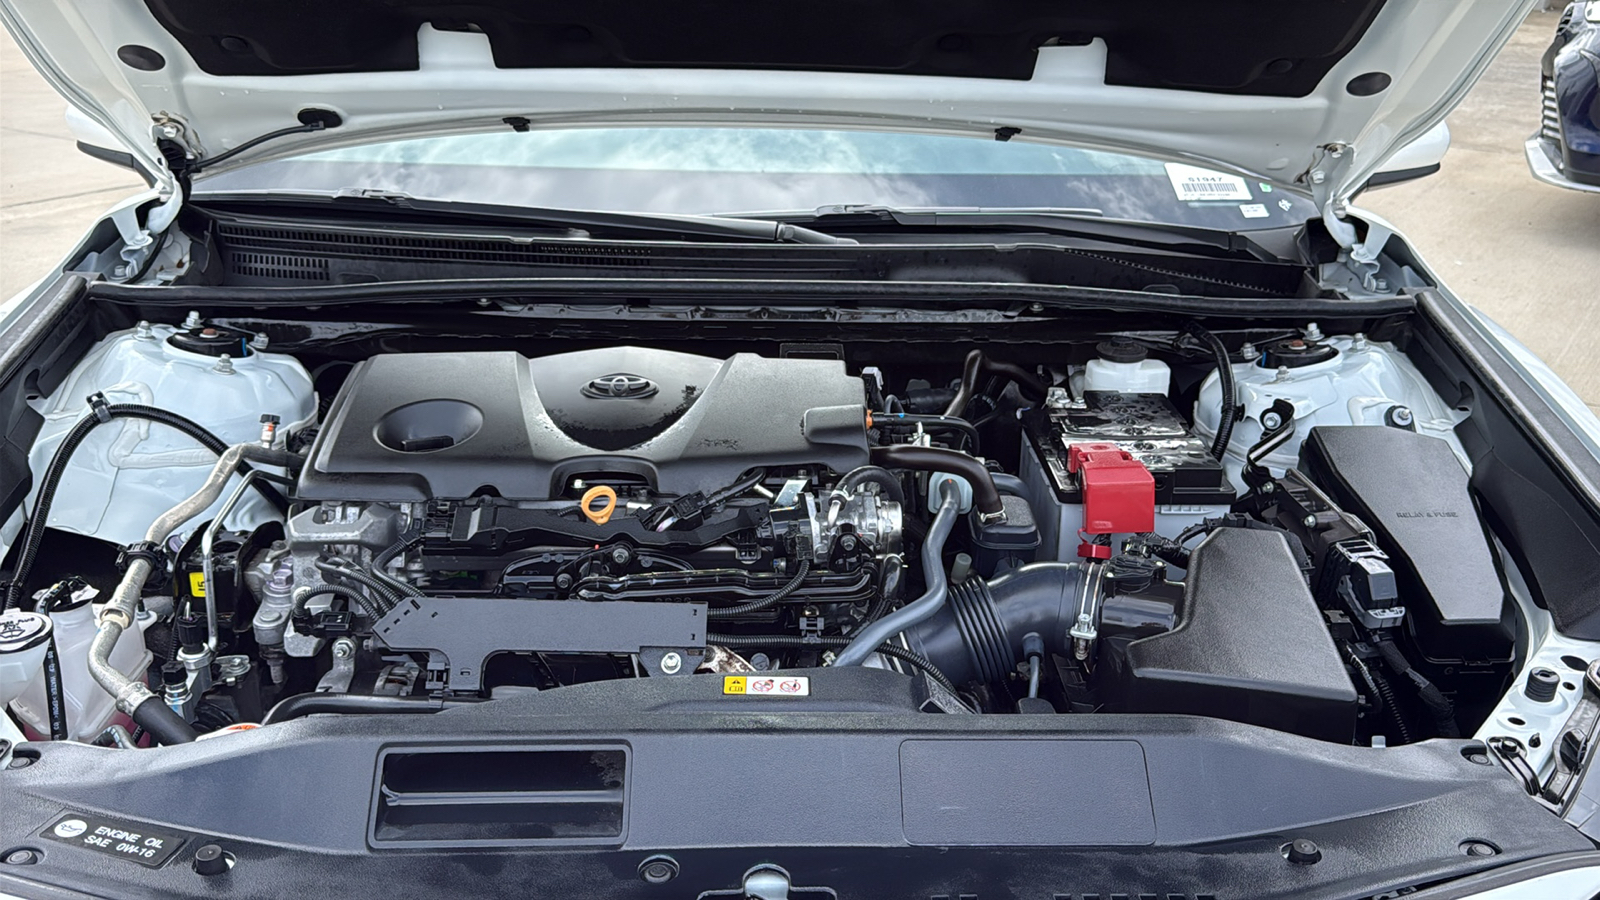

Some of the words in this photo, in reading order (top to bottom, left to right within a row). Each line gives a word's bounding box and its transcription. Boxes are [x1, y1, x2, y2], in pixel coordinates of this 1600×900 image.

[84, 835, 112, 848] SAE
[116, 843, 156, 858] 0W-16
[94, 826, 141, 843] ENGINE
[144, 838, 164, 849] OIL
